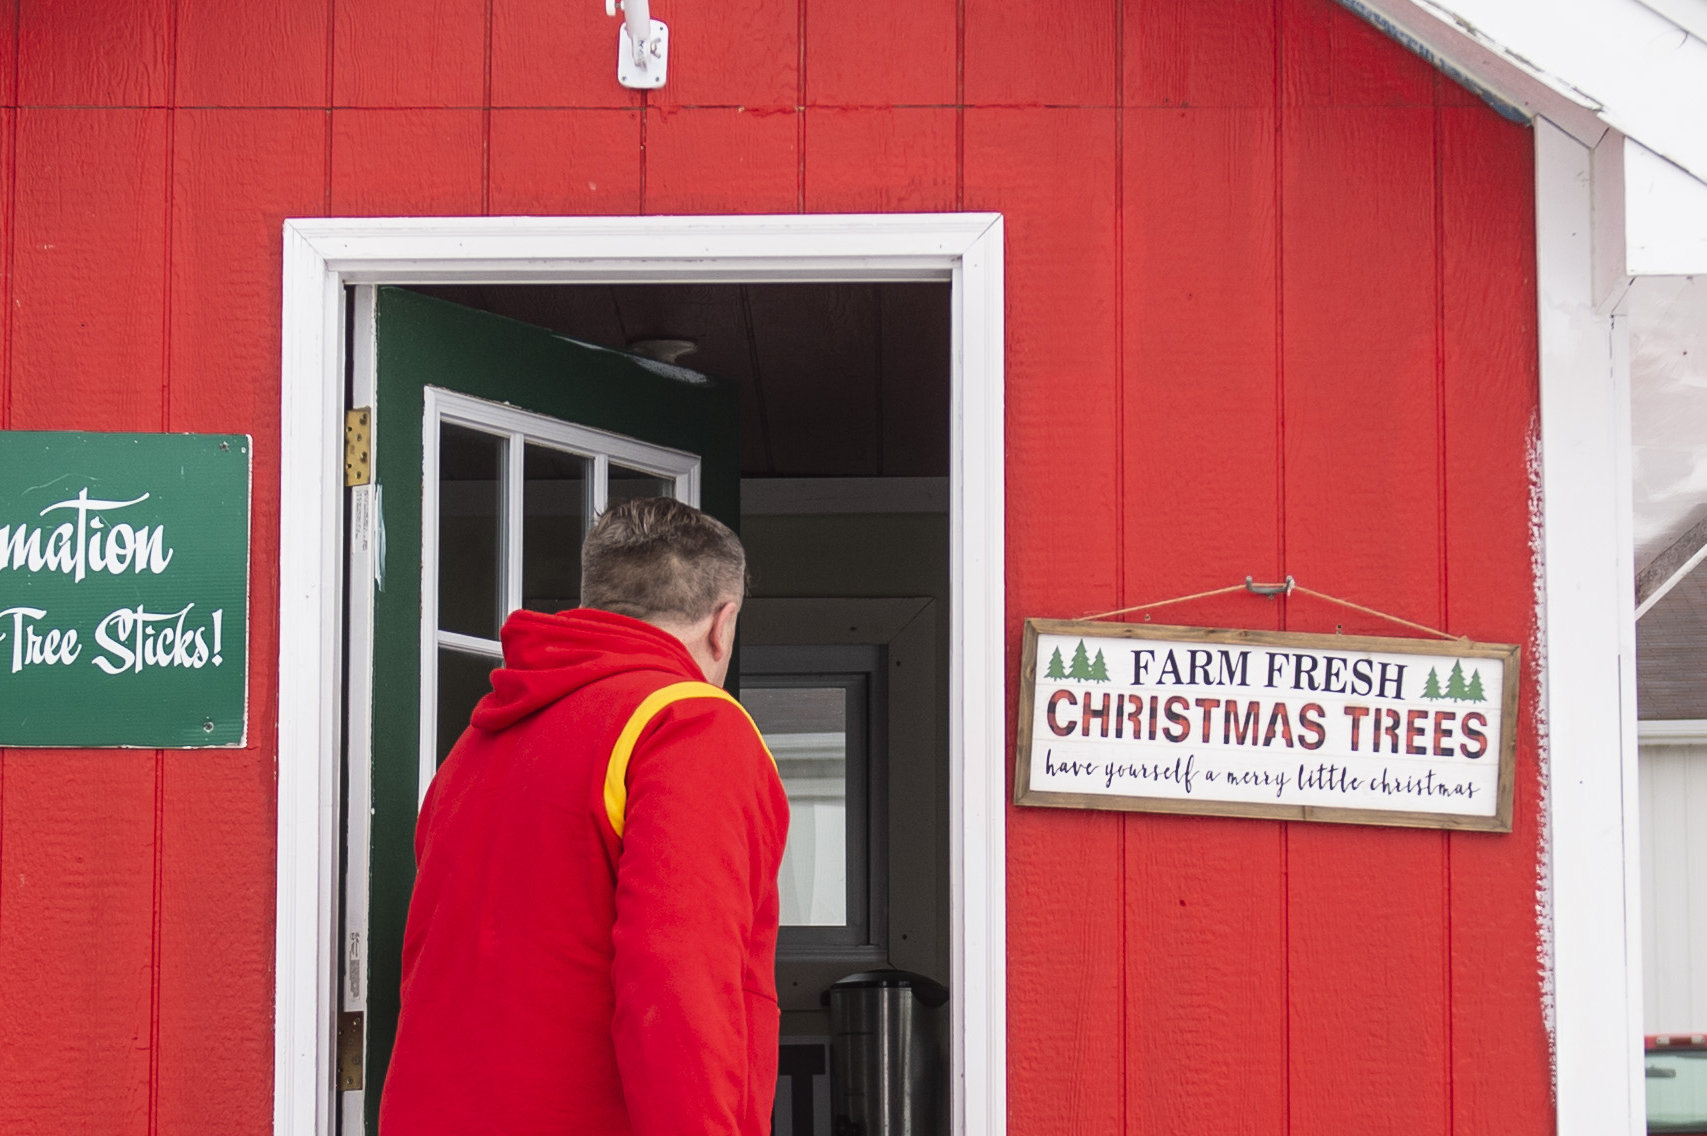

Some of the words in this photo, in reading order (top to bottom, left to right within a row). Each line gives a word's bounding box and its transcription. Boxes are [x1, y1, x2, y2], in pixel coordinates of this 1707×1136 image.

[91, 602, 224, 675] Sticks!
[1130, 649, 1252, 688] FARM
[1264, 652, 1409, 701] FRESH
[1046, 688, 1327, 751] CHRISTMAS
[1343, 705, 1488, 760] TREES
[1045, 748, 1099, 777] have
[1104, 754, 1200, 794] yourself
[1205, 770, 1221, 783] a
[1227, 770, 1292, 799] merry
[1297, 763, 1366, 794] little
[1369, 767, 1482, 800] christmas
